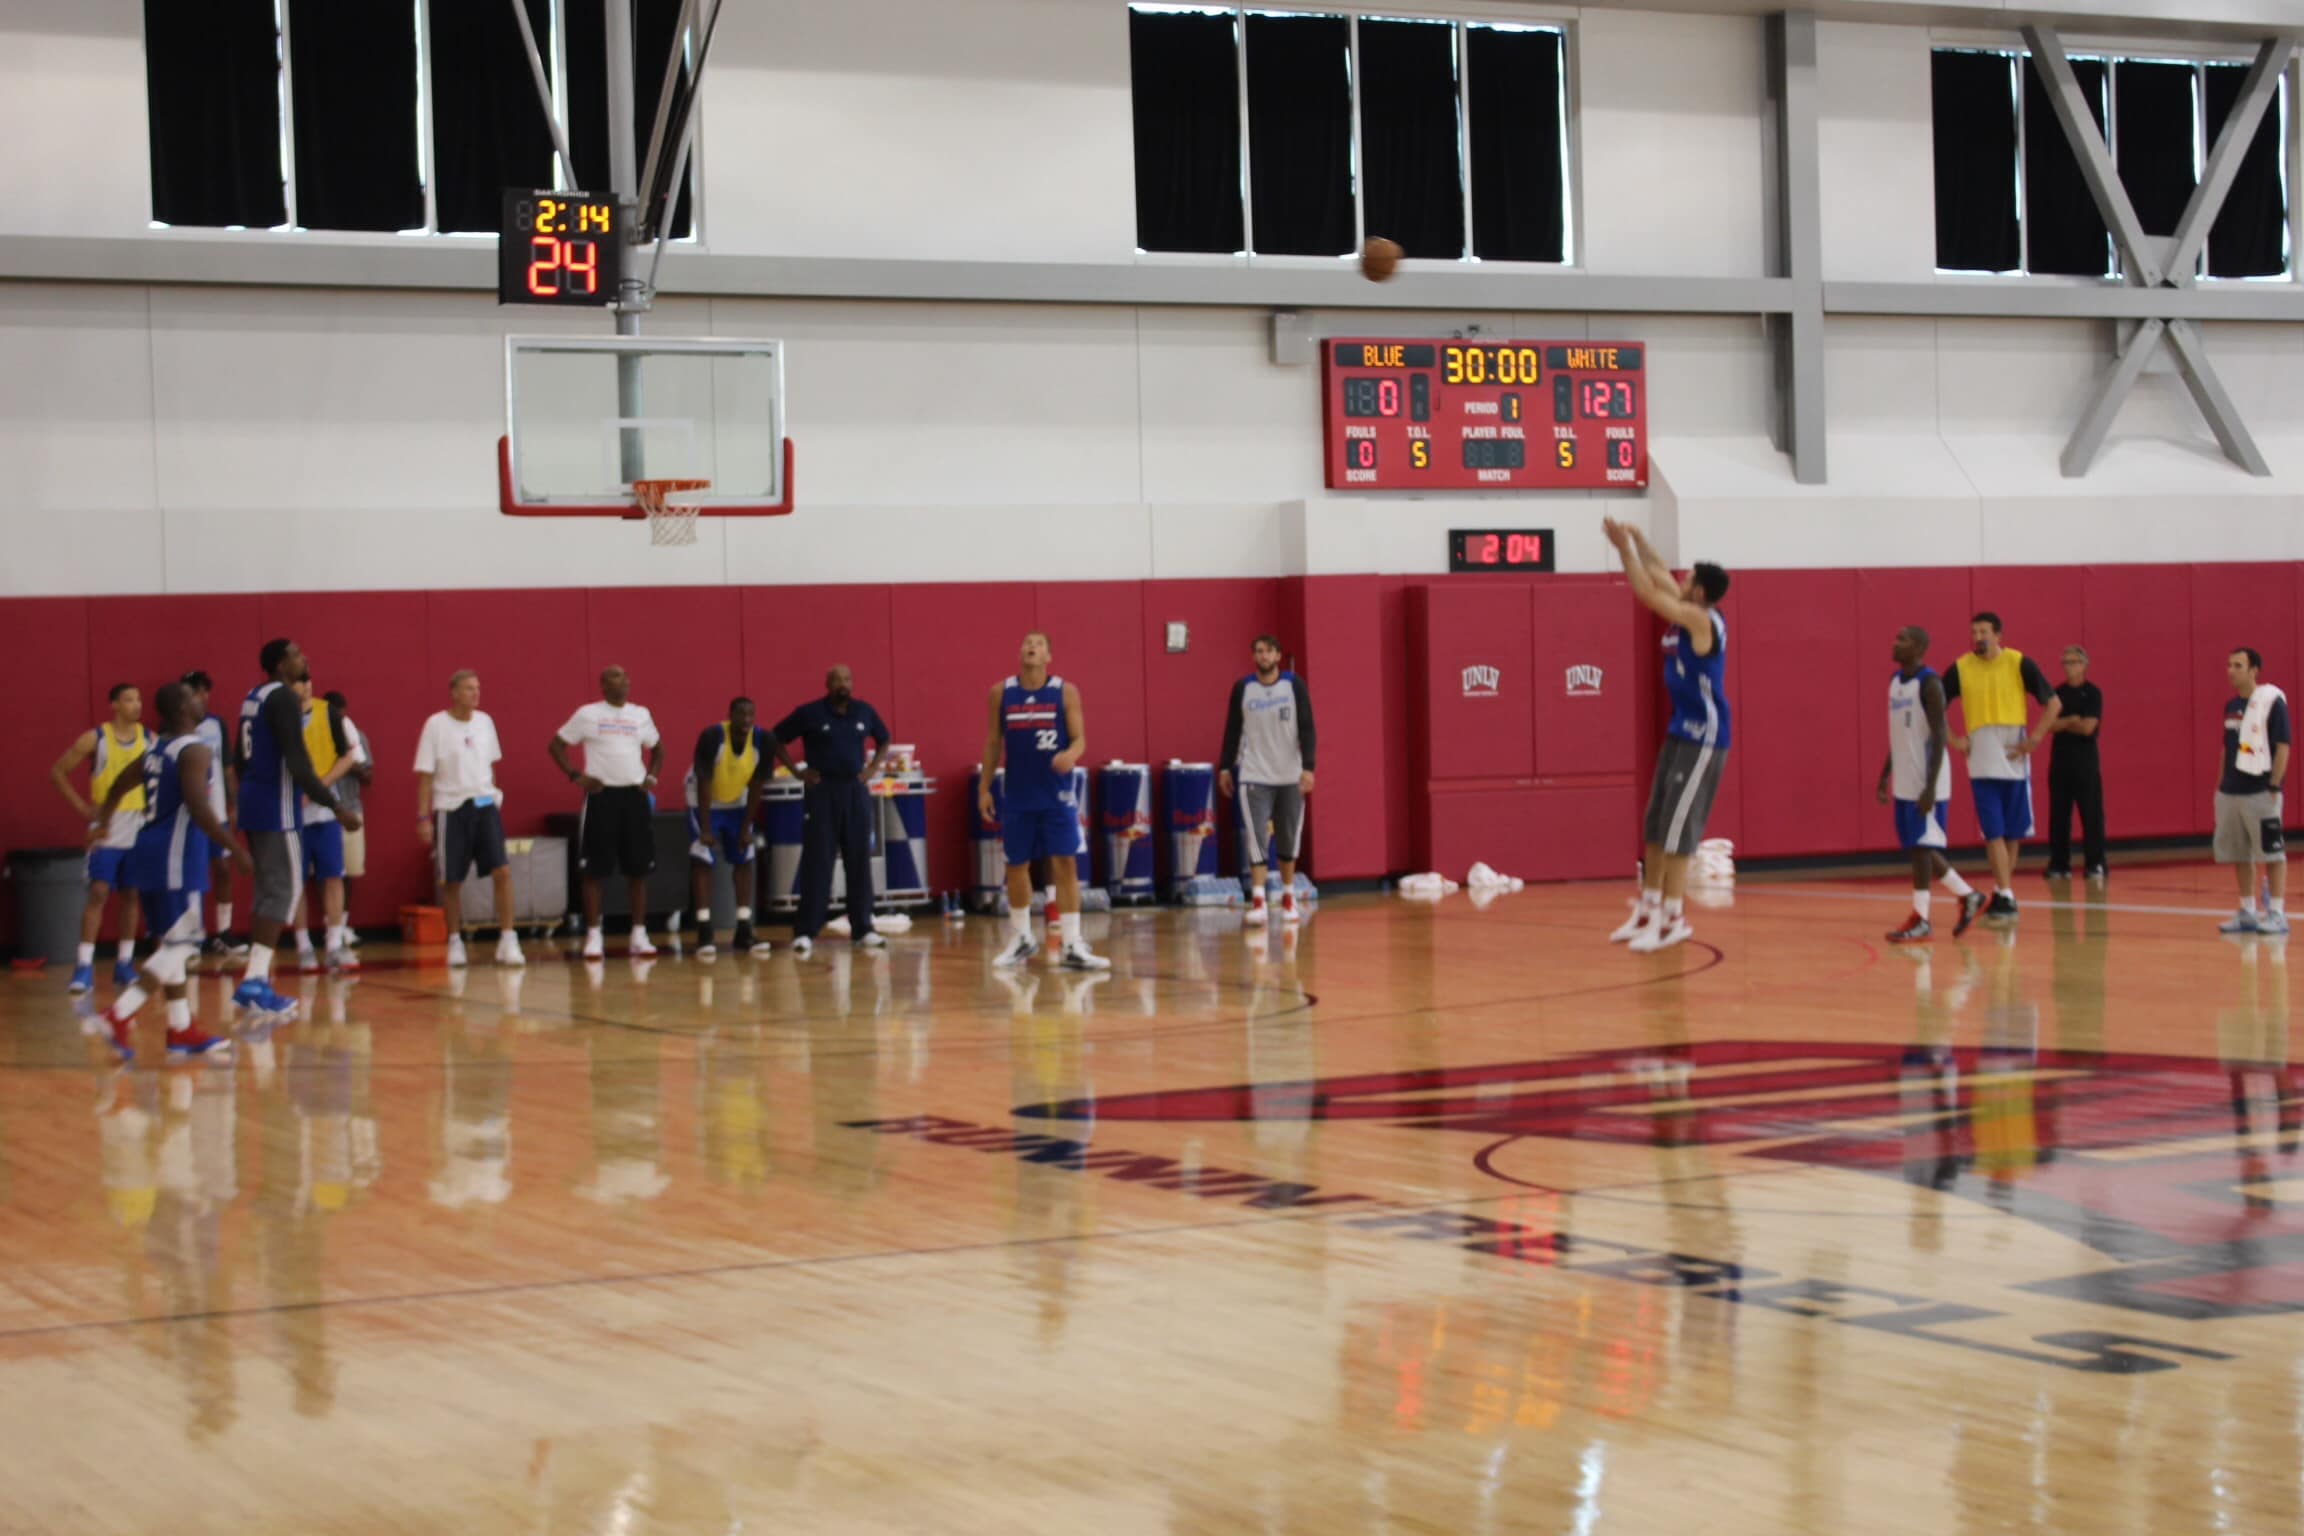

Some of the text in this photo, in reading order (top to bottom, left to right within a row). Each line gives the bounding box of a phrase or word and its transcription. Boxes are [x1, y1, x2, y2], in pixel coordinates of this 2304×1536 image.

[535, 199, 610, 233] 2:14
[528, 236, 597, 295] 24
[1362, 344, 1405, 367] BLUE
[1446, 347, 1538, 384] 30:00
[1566, 347, 1618, 370] WHITE
[1378, 379, 1398, 416] 0
[1463, 401, 1499, 414] PERIOD
[1511, 398, 1519, 419] 1
[1583, 381, 1632, 417] 127
[1345, 426, 1377, 438] FOULS
[1461, 426, 1525, 439] PLAYER FOUL
[1605, 426, 1635, 439] FOULS
[1358, 440, 1374, 468] 0
[1411, 440, 1428, 468] 5
[1558, 441, 1573, 468] 5
[1618, 441, 1633, 468] 0
[1345, 469, 1377, 482] SCORE
[1477, 469, 1511, 481] MATCH
[1606, 469, 1635, 481] SCORE
[242, 719, 253, 761] 6
[1035, 729, 1058, 750] 32
